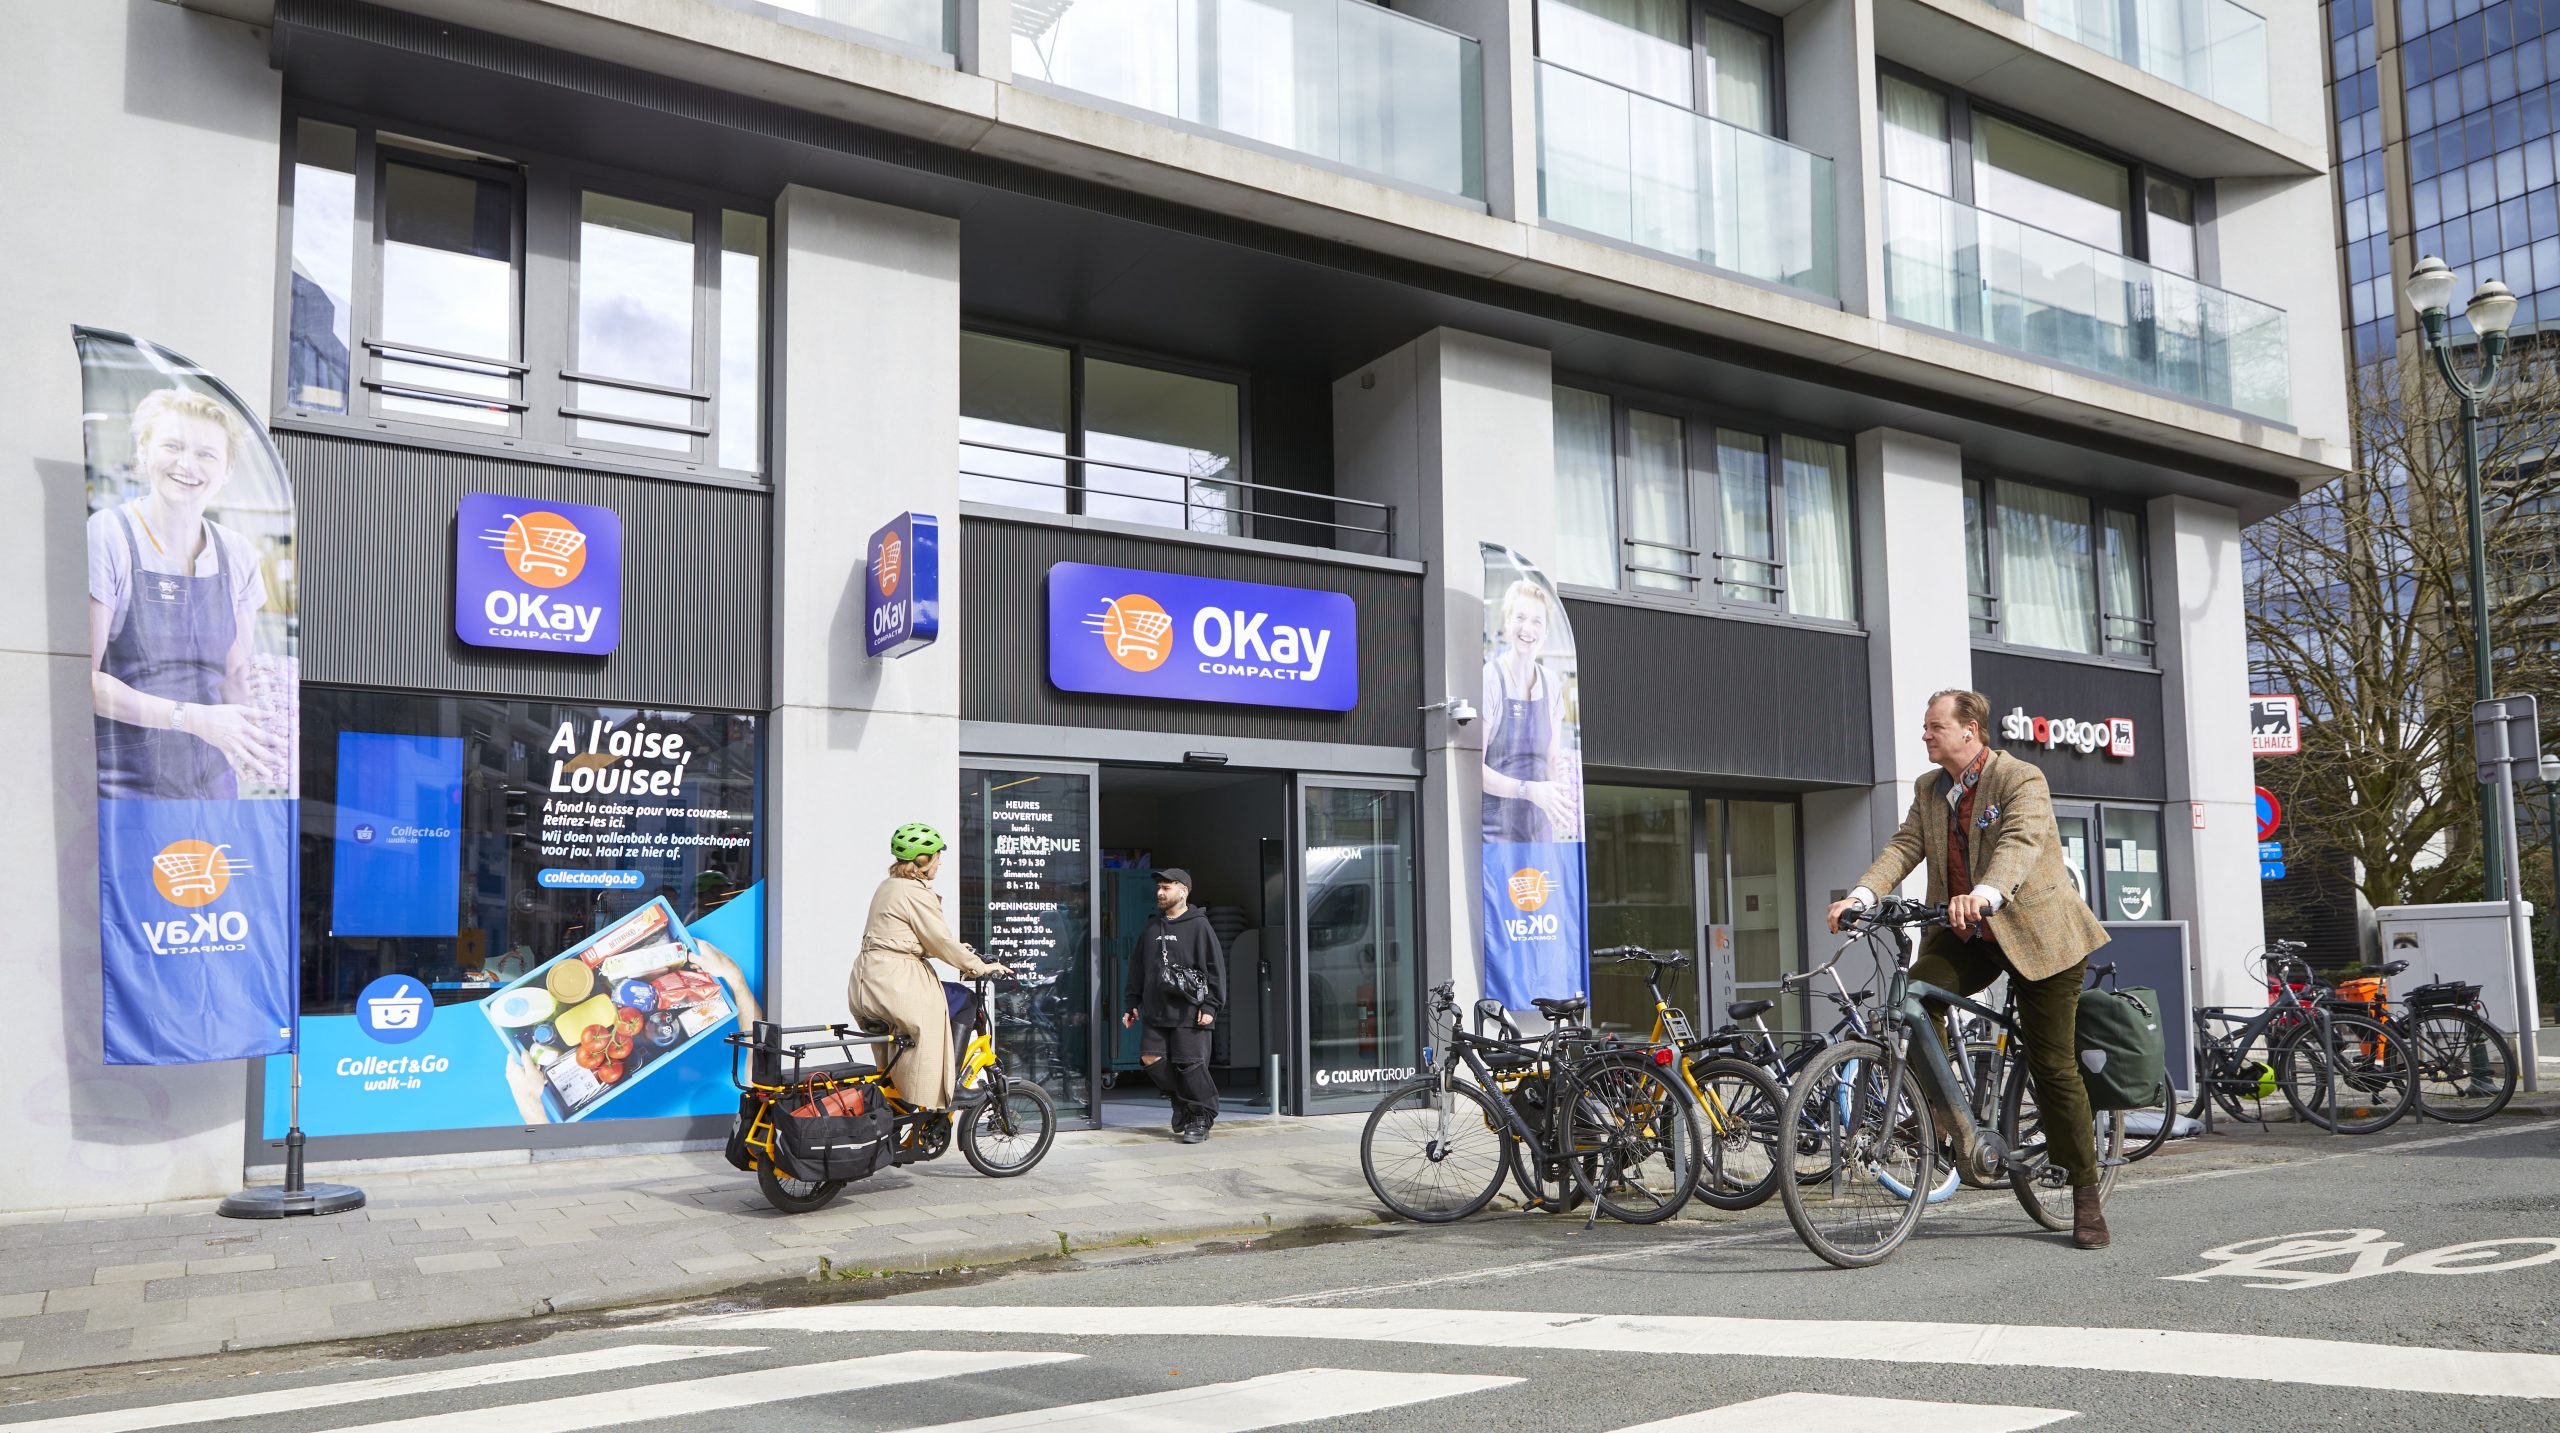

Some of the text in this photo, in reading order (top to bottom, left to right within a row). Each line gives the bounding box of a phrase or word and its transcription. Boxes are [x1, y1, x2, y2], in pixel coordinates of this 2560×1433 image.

[485, 590, 602, 642] OKay
[873, 600, 907, 636] OKay
[489, 627, 574, 642] COMPACT
[874, 630, 898, 646] COMPACT
[1193, 606, 1331, 681] OKay
[1198, 662, 1298, 680] COMPACT
[2002, 706, 2110, 754] shop&go
[548, 719, 692, 765] A l'aise,
[2252, 736, 2293, 749] ELHAIZE
[549, 759, 684, 796] Louise!
[542, 798, 731, 820] À fond la caisse pour vos courses.
[1006, 800, 1040, 810] HEURES
[543, 814, 626, 829] Retirez-les ici.
[993, 812, 1053, 822] D'OUVERTURE
[2195, 807, 2202, 824] H
[391, 826, 451, 838] Collect&Go
[1011, 824, 1030, 832] lundi
[541, 830, 750, 849] Wij doen vollenbak de boodschappen
[996, 837, 1081, 852] BIENVENUE
[541, 845, 681, 861] voor jou. Haal ze hier af.
[1018, 859, 1027, 867] 19
[1035, 859, 1046, 867] 30
[544, 872, 637, 887] collectandgo.be
[1003, 870, 1039, 879] dimanche
[1006, 881, 1012, 890] 8
[1025, 882, 1034, 890] 12
[2122, 885, 2141, 895] ingang
[988, 902, 1058, 911] OPENINGSUREN
[1006, 914, 1040, 924] maandag:
[993, 926, 1002, 934] 12
[1012, 926, 1022, 934] tot
[1024, 926, 1044, 934] 19.30
[990, 937, 1018, 948] dinsdag
[1024, 937, 1056, 948] zaterdag:
[1019, 949, 1039, 957] 19.30
[1009, 961, 1037, 971] zondag:
[1016, 972, 1027, 980] tot
[1029, 972, 1037, 980] 12
[336, 1054, 449, 1076] Collect&Go
[364, 1075, 421, 1091] walk-in
